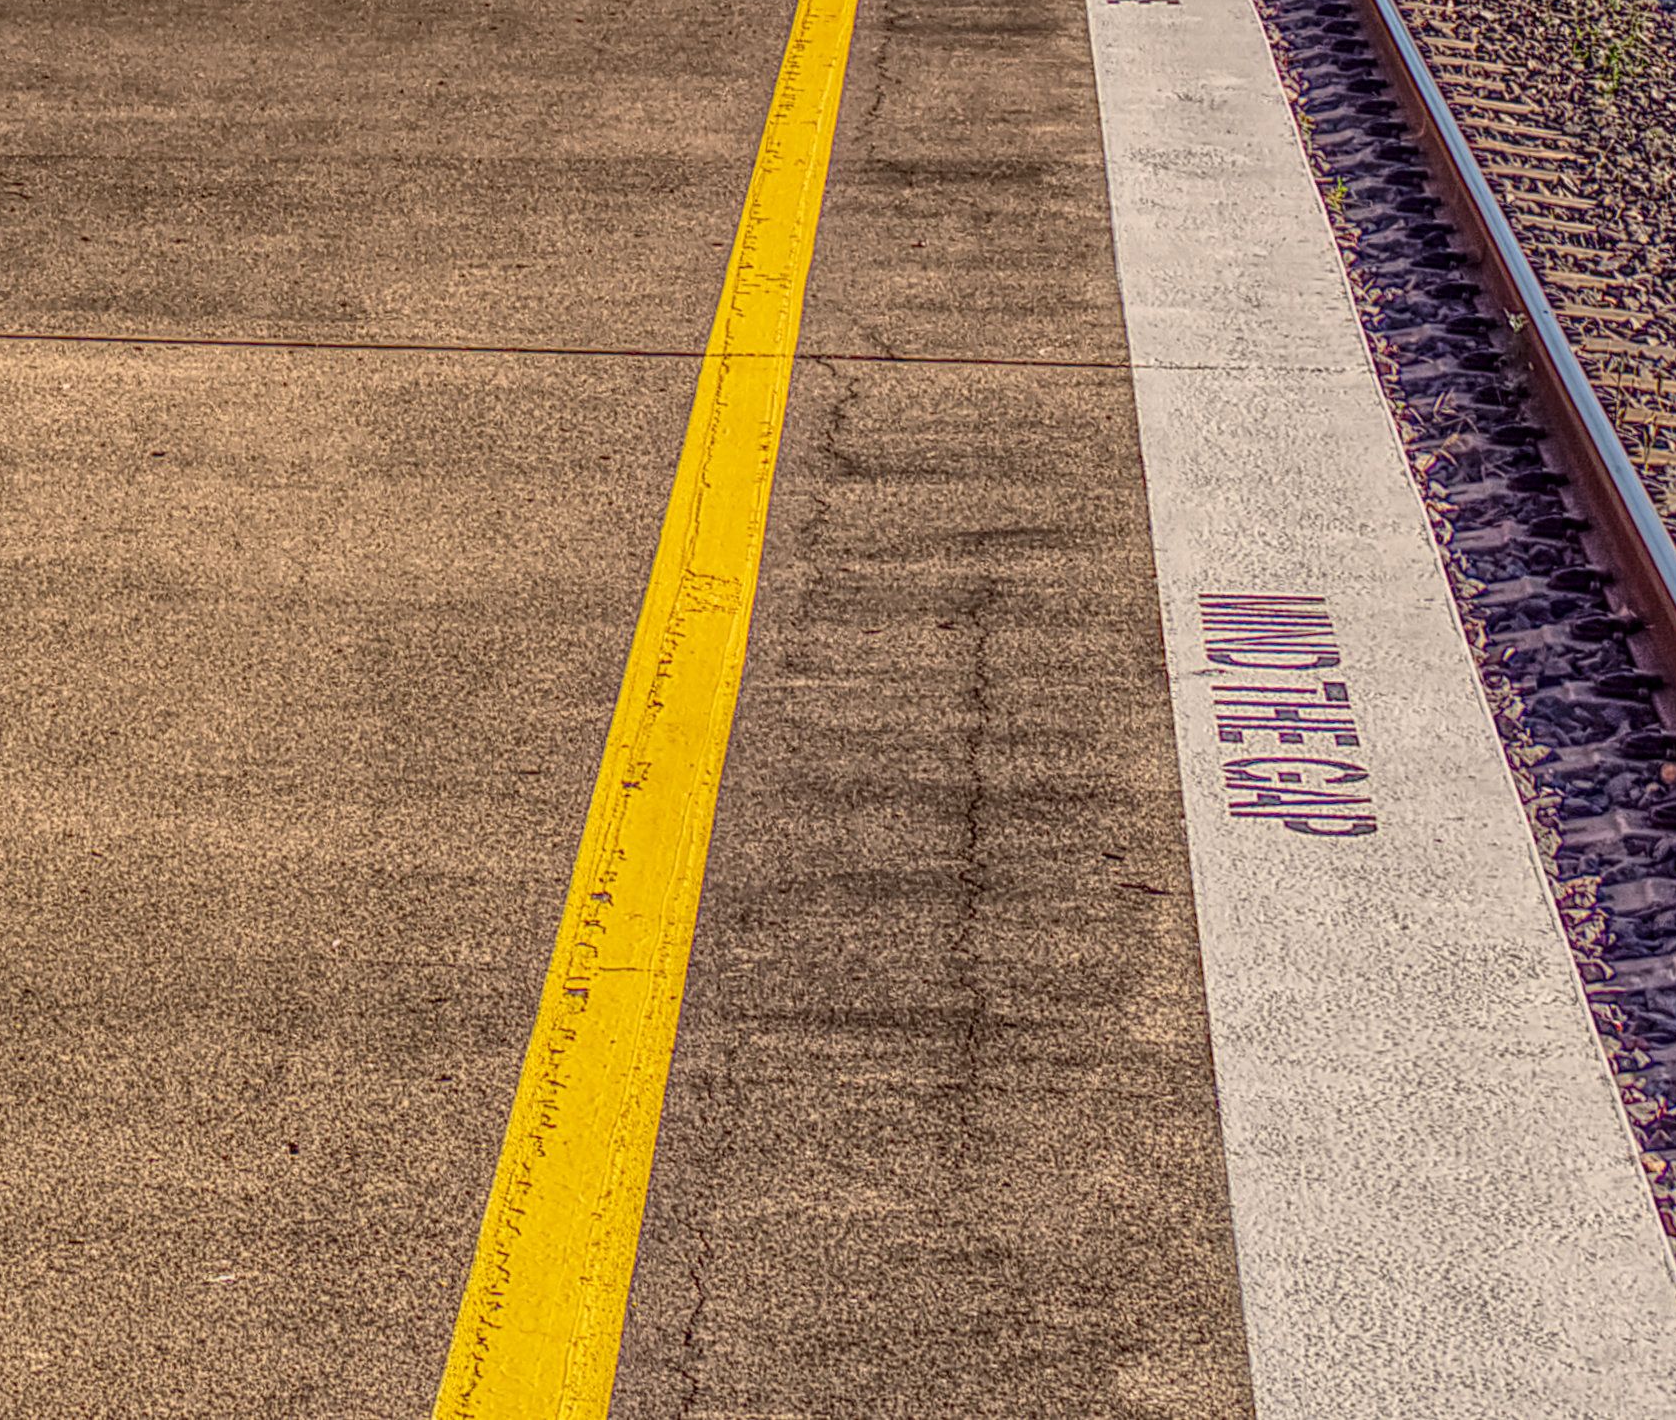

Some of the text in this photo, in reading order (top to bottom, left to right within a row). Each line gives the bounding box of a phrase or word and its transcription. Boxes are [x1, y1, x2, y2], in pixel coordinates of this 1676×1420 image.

[1198, 593, 1378, 836] MIND THE GAP
